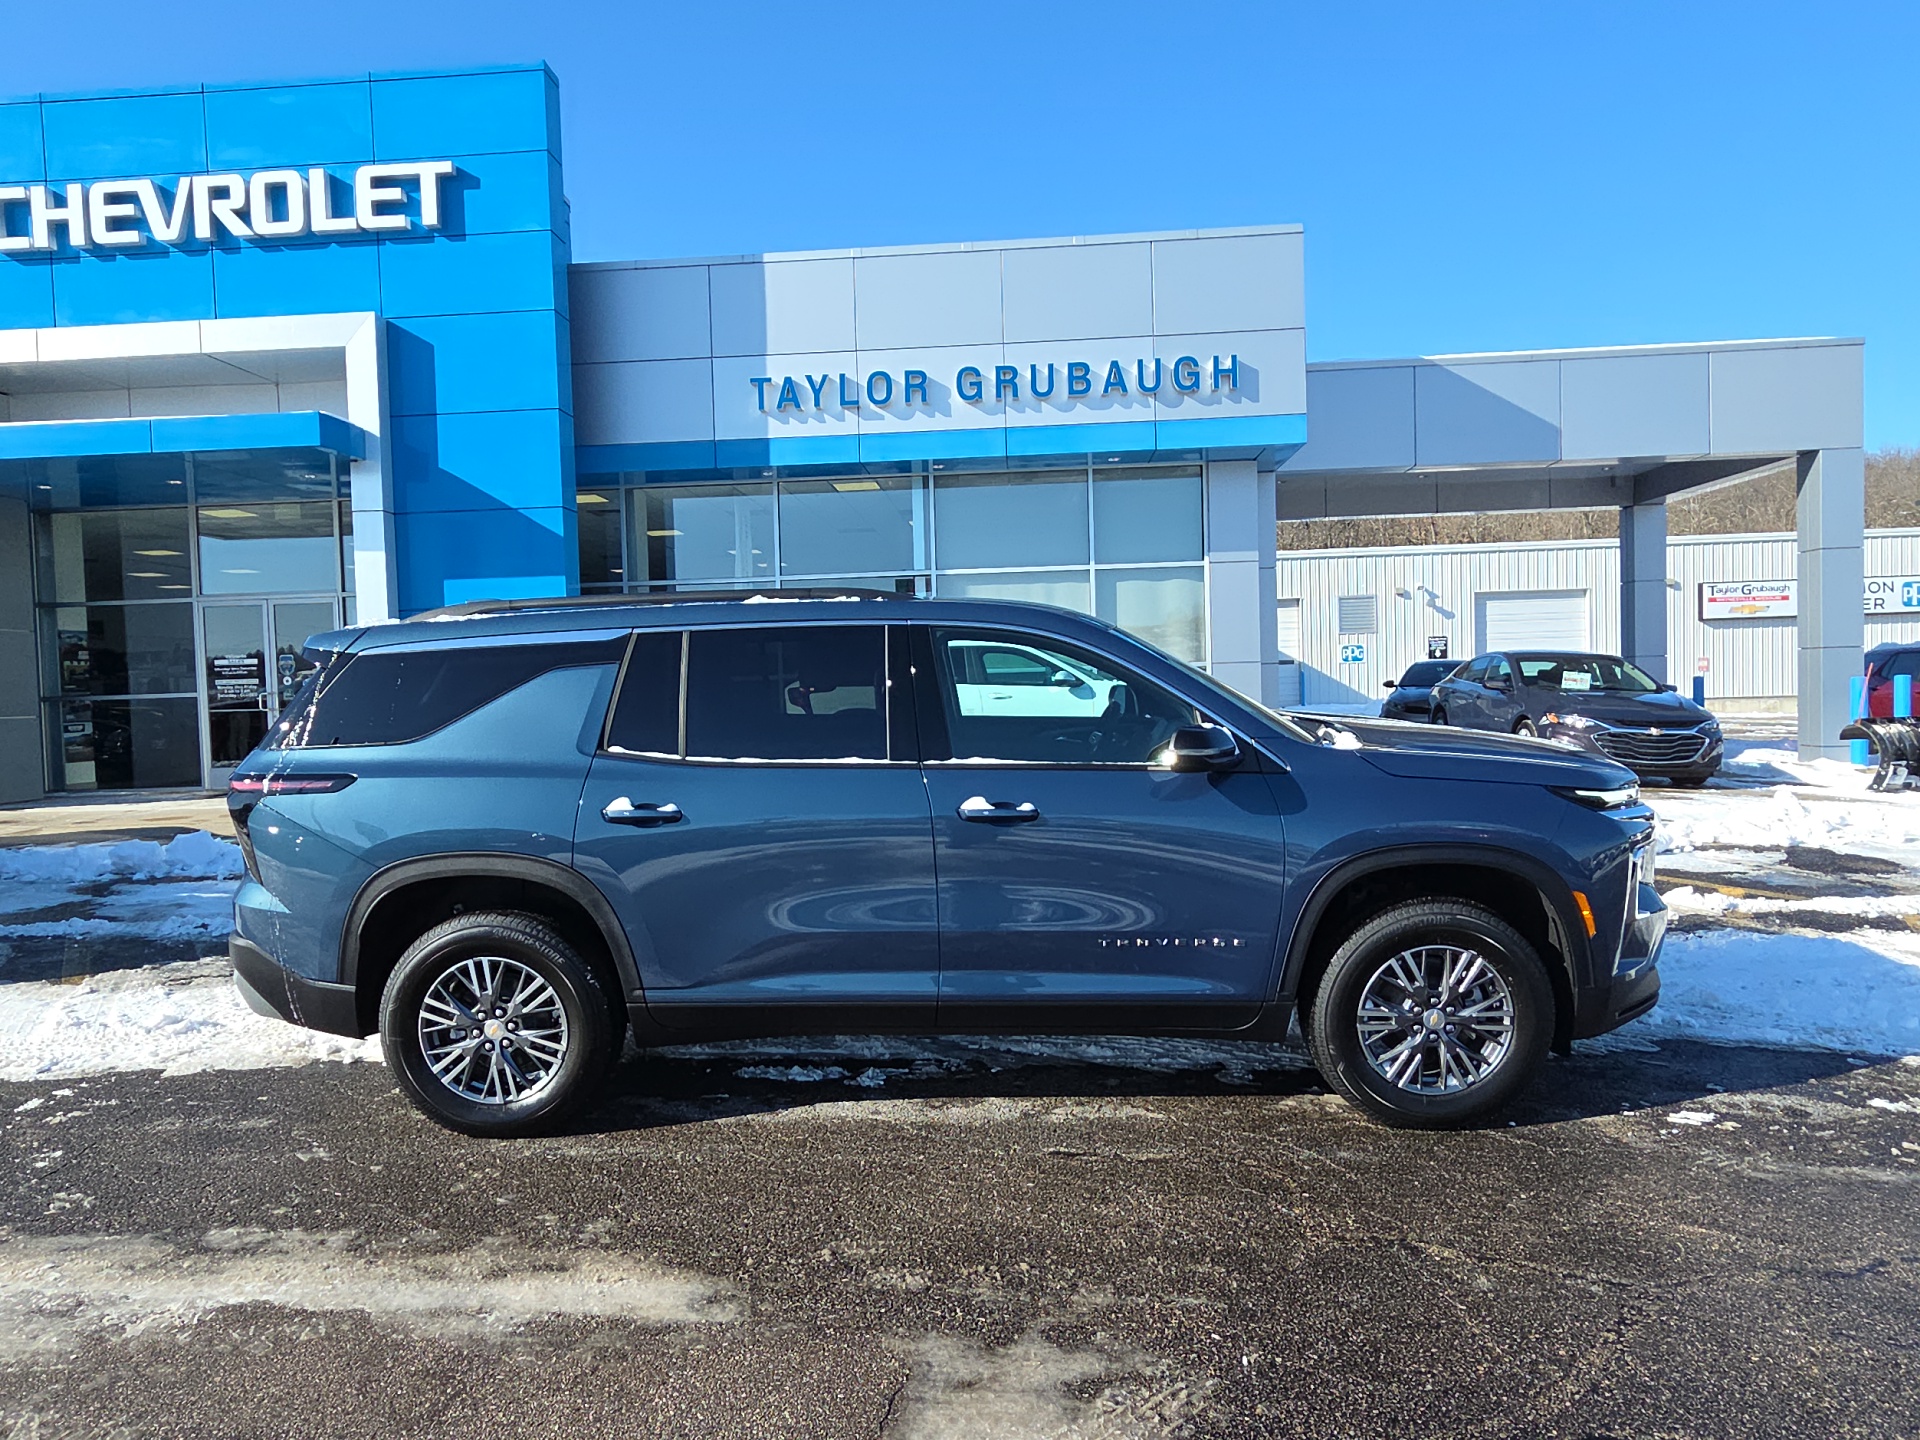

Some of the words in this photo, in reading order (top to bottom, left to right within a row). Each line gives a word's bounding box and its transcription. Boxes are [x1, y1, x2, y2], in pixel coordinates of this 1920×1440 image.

[0, 160, 456, 251] CHEVROLET
[750, 370, 929, 412] TAYLOR
[956, 354, 1240, 403] GRUBAUGH
[1707, 585, 1739, 596] Taylor
[1741, 583, 1790, 595] Grubaugh
[1342, 645, 1364, 661] PPG
